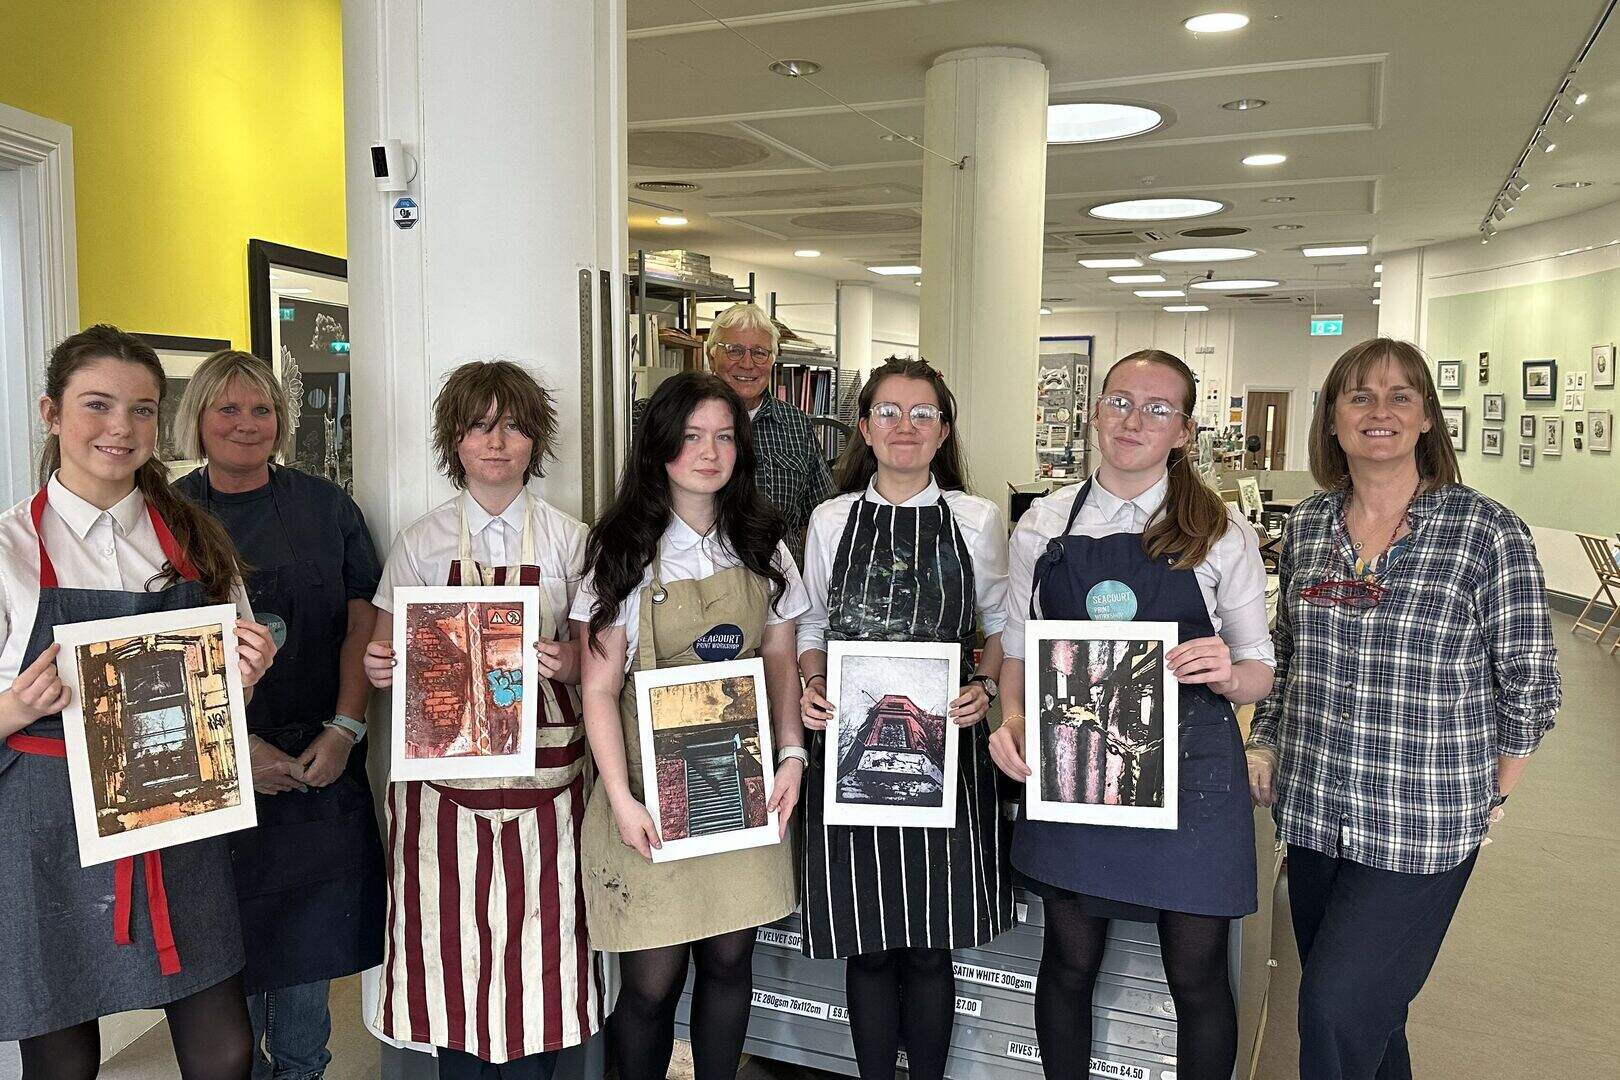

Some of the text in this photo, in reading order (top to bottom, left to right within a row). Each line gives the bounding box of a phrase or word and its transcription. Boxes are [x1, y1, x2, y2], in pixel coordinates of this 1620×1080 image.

[1092, 592, 1130, 604] SEACOURT
[697, 634, 740, 643] SEACOURT
[763, 930, 788, 944] VELVET
[953, 965, 1032, 988] SATIN WHITE 300gsm
[763, 994, 789, 1007] 280gsm
[790, 1000, 821, 1014] 76x112cm
[956, 998, 977, 1011] £7.00
[1010, 1042, 1033, 1057] RIVES
[1120, 1065, 1144, 1080] £4.50
